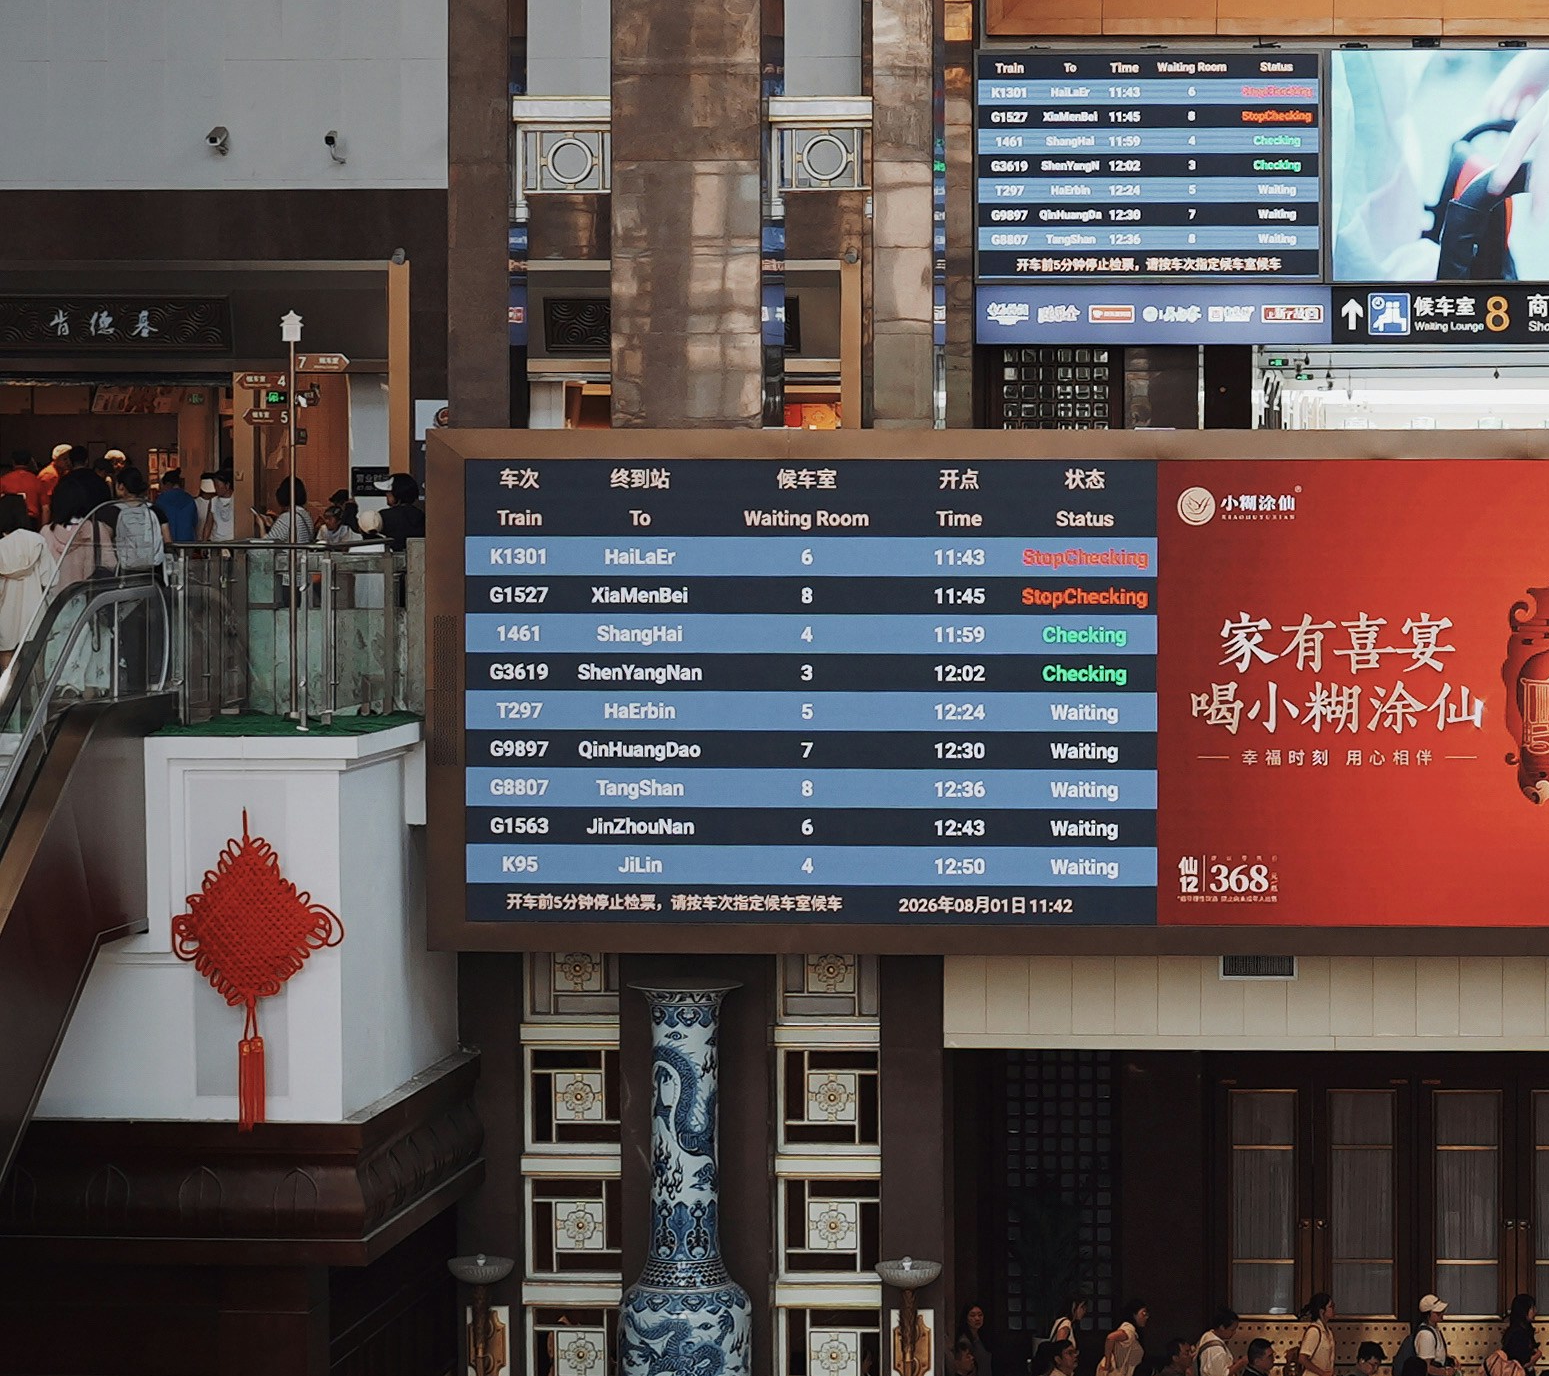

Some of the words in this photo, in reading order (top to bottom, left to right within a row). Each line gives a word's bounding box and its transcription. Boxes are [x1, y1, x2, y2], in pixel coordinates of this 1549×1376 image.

[995, 62, 1024, 73] Train
[1064, 63, 1077, 73] To
[1110, 62, 1139, 74] Time
[1157, 62, 1195, 74] Waiting
[1198, 62, 1227, 72] Room
[1260, 61, 1293, 72] Status
[991, 111, 1028, 123] G1527
[1109, 110, 1141, 123] 11:45
[1414, 297, 1475, 316] 候车室
[1486, 296, 1509, 331] 8
[1414, 320, 1450, 333] Waiting
[1450, 322, 1484, 333] Lounge
[298, 357, 306, 368] 7
[278, 376, 286, 386] 4
[281, 411, 288, 423] 5
[500, 468, 539, 488] 车次
[610, 468, 670, 489] 终到站
[777, 468, 837, 489] 候车室
[939, 468, 979, 489] 开点
[1065, 469, 1106, 489] 状态
[1220, 494, 1295, 513] 小糊涂仙
[497, 509, 542, 525] Train
[629, 509, 651, 526] To
[744, 510, 811, 530] Waiting
[817, 509, 870, 527] Room
[936, 510, 982, 526] Time
[1056, 510, 1114, 527] Status
[491, 547, 545, 565] K1301
[605, 547, 677, 564] HaiLaEr
[802, 549, 814, 565] 6
[935, 549, 986, 566] 11:43
[1022, 548, 1149, 570] StopChecking
[490, 587, 548, 603] G1527
[592, 586, 689, 604] XiaMenBei
[802, 587, 812, 603] 8
[934, 588, 985, 605] 11:45
[1021, 587, 1149, 610] StopChecking
[497, 624, 540, 641] 1461
[597, 625, 682, 646] ShangHai
[801, 627, 814, 642] 4
[935, 626, 986, 643] 11:59
[1042, 625, 1127, 647] Checking
[1218, 610, 1456, 675] 家有喜宴
[490, 662, 548, 681] G3619
[578, 663, 702, 684] ShenYangNan
[801, 664, 812, 681] 3
[934, 664, 985, 682] 12:02
[1042, 664, 1127, 686] Checking
[497, 702, 544, 719] T297
[605, 702, 676, 718] HaErbin
[802, 704, 814, 719] 5
[935, 703, 985, 720] 12:24
[1051, 703, 1119, 724] Waiting
[1189, 679, 1484, 736] 喝小糊涂仙
[490, 740, 549, 758] G9897
[578, 741, 701, 762] QinHuangDao
[801, 741, 813, 759] 7
[935, 741, 985, 759] 12:30
[1241, 749, 1329, 767] 幸福时刻
[1345, 749, 1432, 767] 用心相伴
[491, 779, 550, 795] G8807
[596, 779, 685, 800] TangShan
[802, 779, 814, 796] 8
[935, 781, 987, 798] 12:36
[491, 816, 549, 834] G1563
[587, 817, 694, 835] JinZhouNan
[802, 819, 813, 836] 6
[934, 819, 985, 837] 12:43
[503, 856, 538, 873] K95
[619, 856, 662, 874] JiLin
[802, 858, 813, 873] 4
[935, 857, 986, 874] 12:50
[1180, 856, 1198, 874] 仙
[1180, 875, 1199, 894] 12
[1211, 864, 1269, 893] 368
[506, 893, 842, 911] 开车前5分钟停止检票，请按车次指定候车室候车
[899, 895, 1025, 914] 2026年08月01日
[1030, 899, 1073, 913] 11:42
